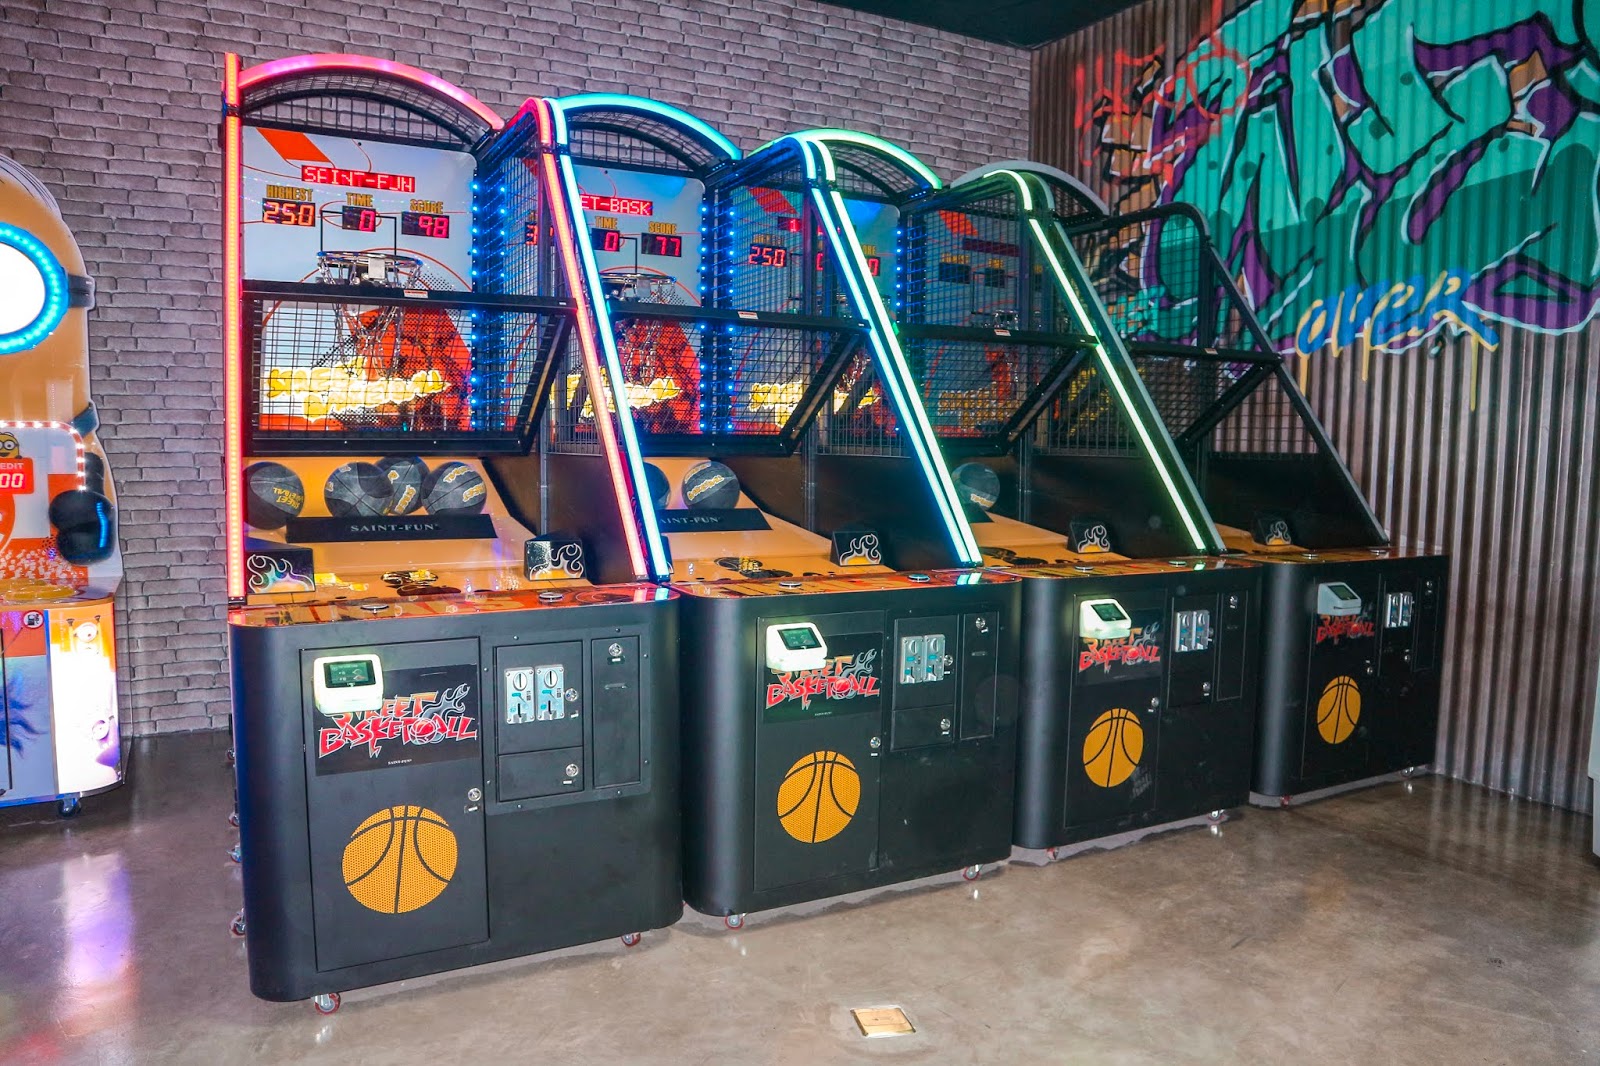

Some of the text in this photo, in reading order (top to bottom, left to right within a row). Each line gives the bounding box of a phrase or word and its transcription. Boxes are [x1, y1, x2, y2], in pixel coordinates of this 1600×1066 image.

[266, 185, 313, 202] HIGHEST
[346, 192, 373, 207] TIME
[263, 201, 315, 226] 250
[410, 199, 443, 214] SCORE
[360, 210, 375, 232] 0
[418, 215, 449, 238] 98
[595, 216, 618, 229] TIME
[648, 221, 677, 235] SCORE
[604, 231, 619, 251] 0
[656, 236, 681, 256] 77
[749, 246, 786, 267] 250
[350, 523, 435, 532] SAINT-FUN
